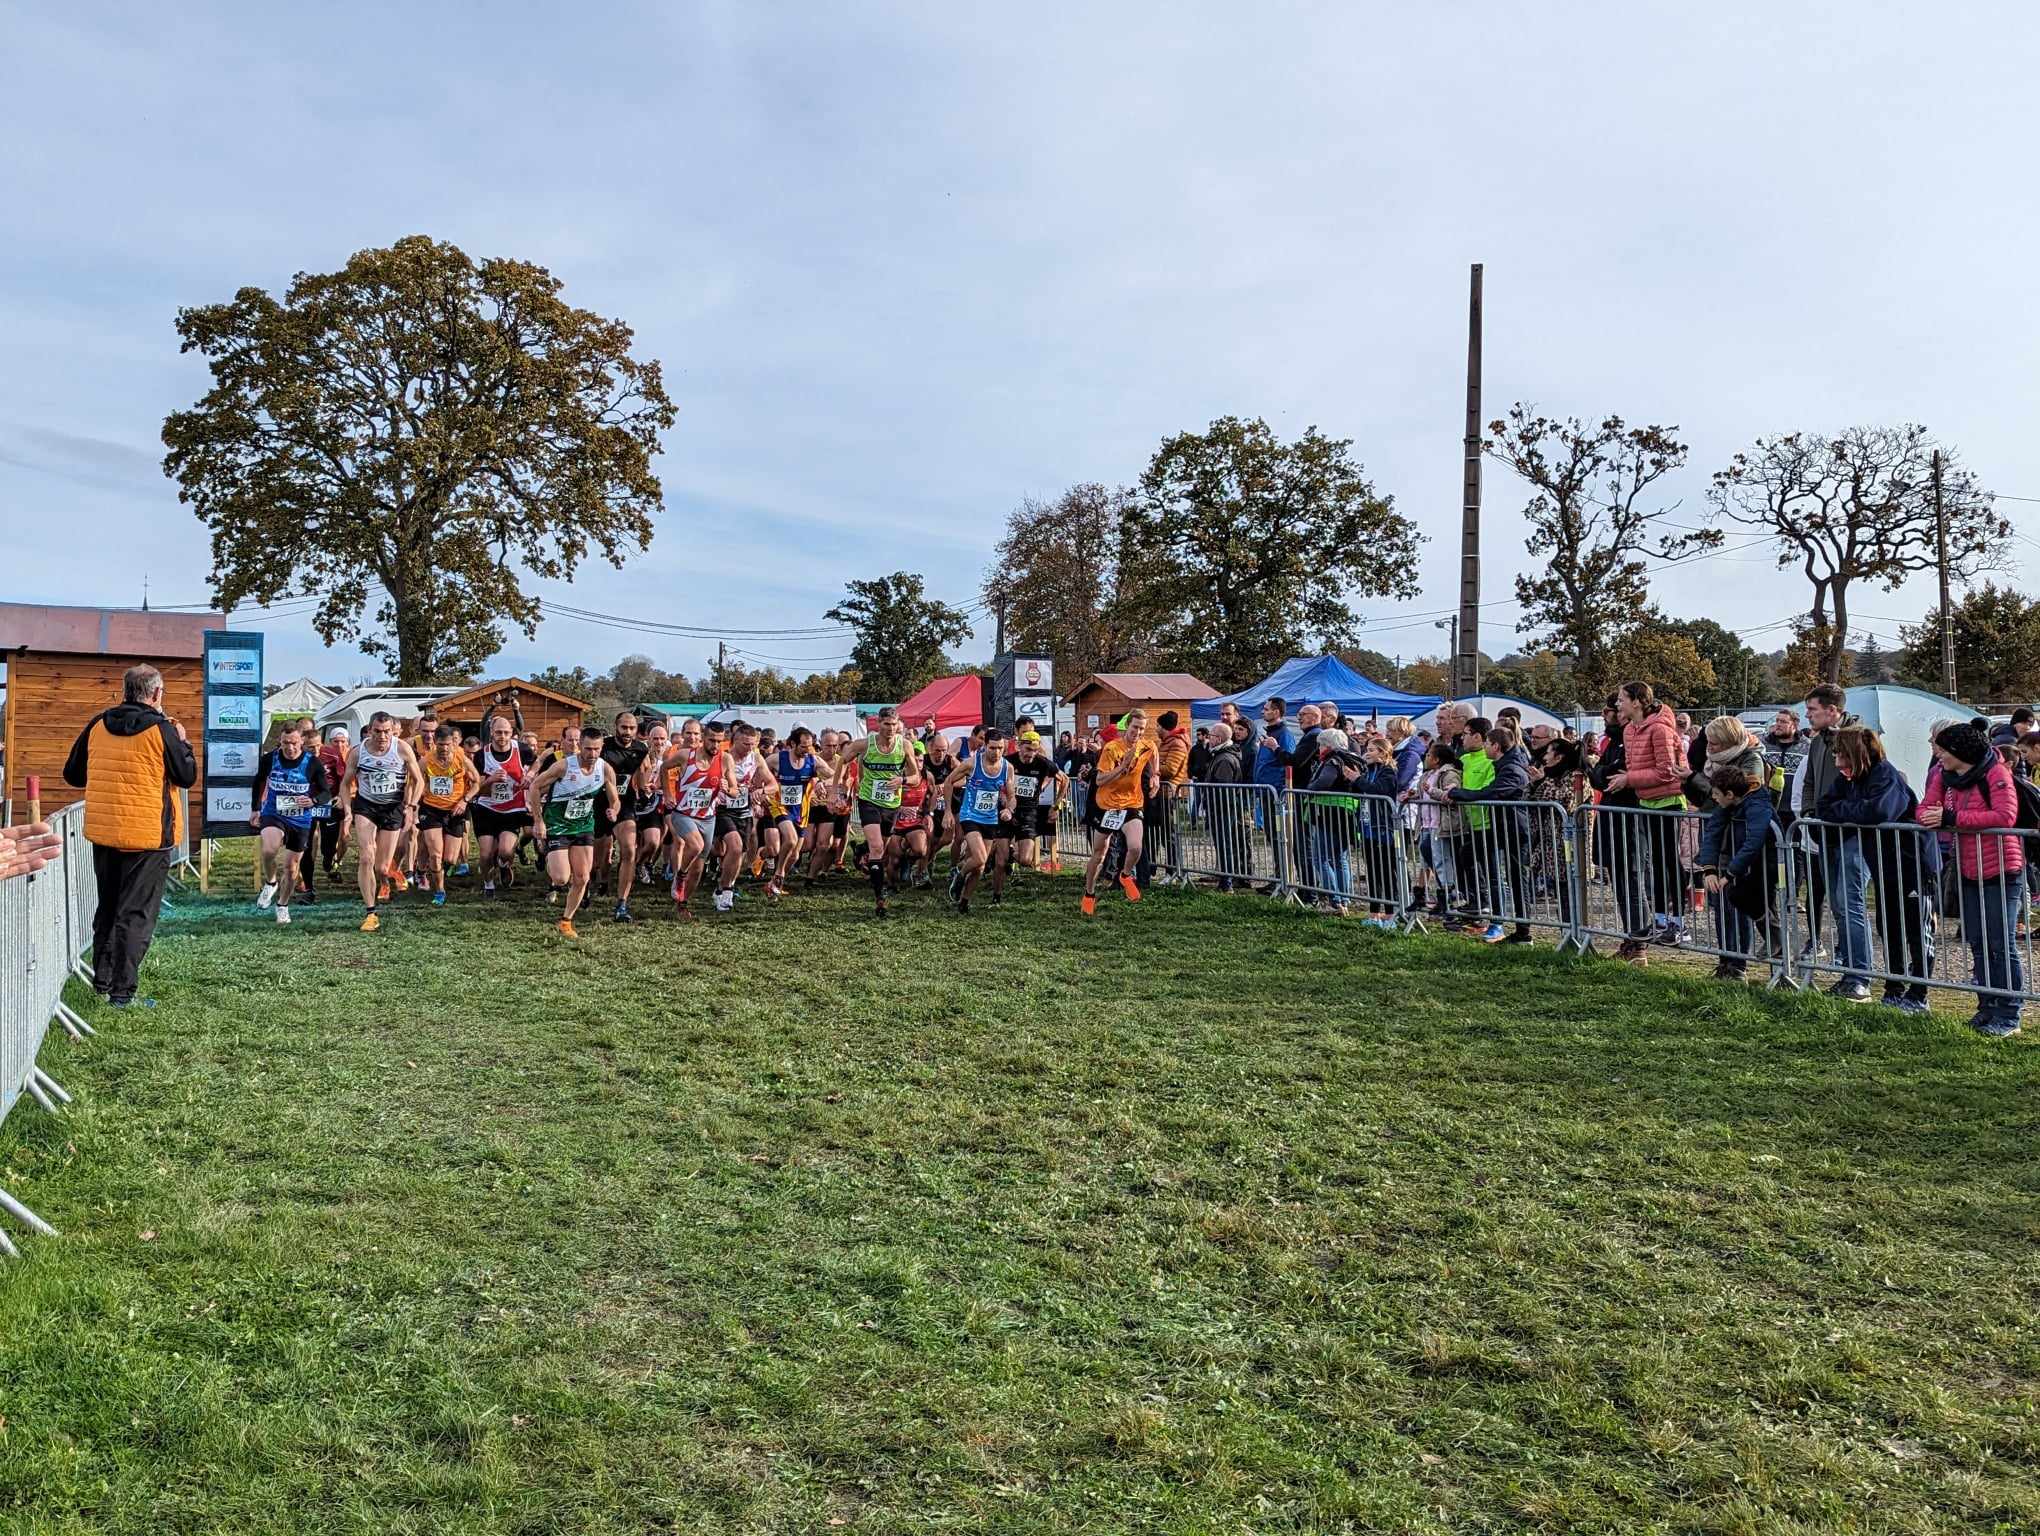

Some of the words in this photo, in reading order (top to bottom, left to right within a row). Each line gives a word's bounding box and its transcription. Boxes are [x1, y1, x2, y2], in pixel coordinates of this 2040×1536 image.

[219, 661, 255, 671] INTERSPORT
[372, 783, 396, 793] 1174
[874, 791, 892, 800] 865
[1105, 820, 1120, 829] 827
